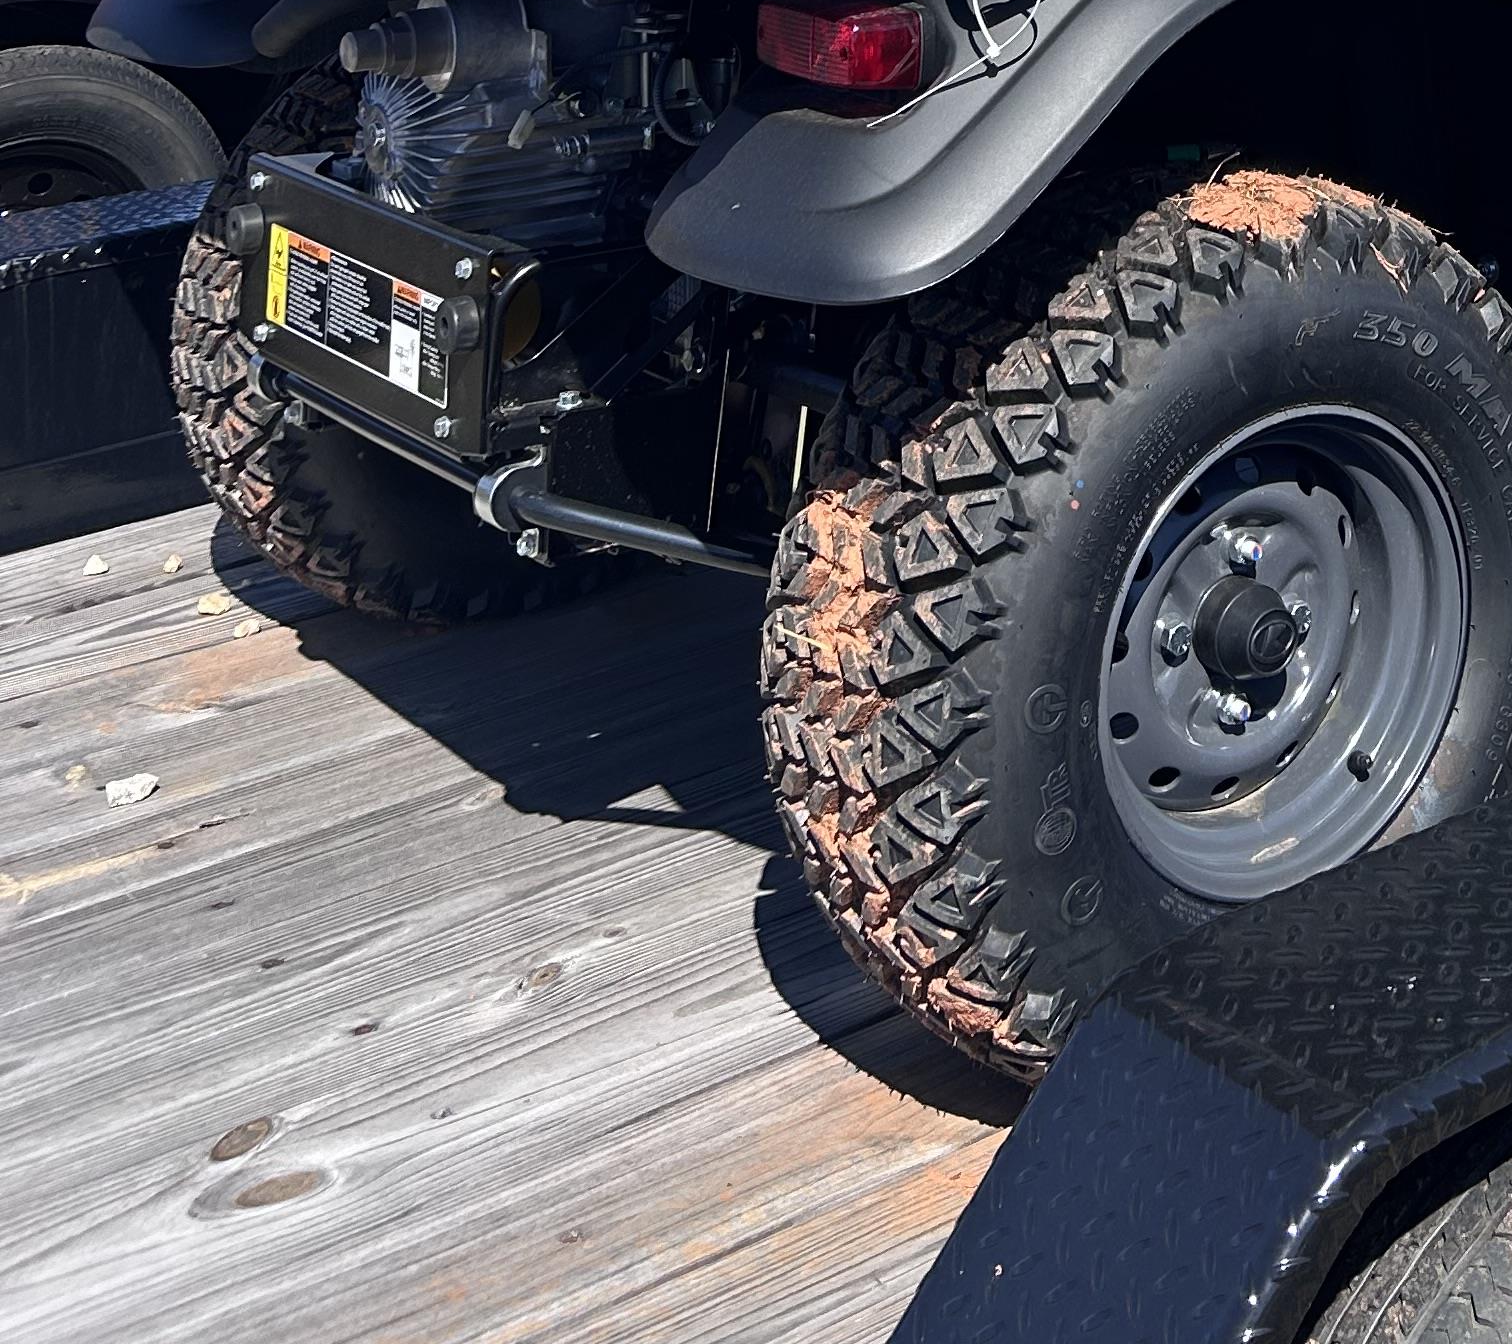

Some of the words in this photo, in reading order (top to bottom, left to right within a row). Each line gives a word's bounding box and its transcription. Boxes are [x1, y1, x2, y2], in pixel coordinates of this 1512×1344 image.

[1353, 310, 1439, 357] 350
[1413, 363, 1447, 393] FOR
[1451, 395, 1504, 469] SERVICE
